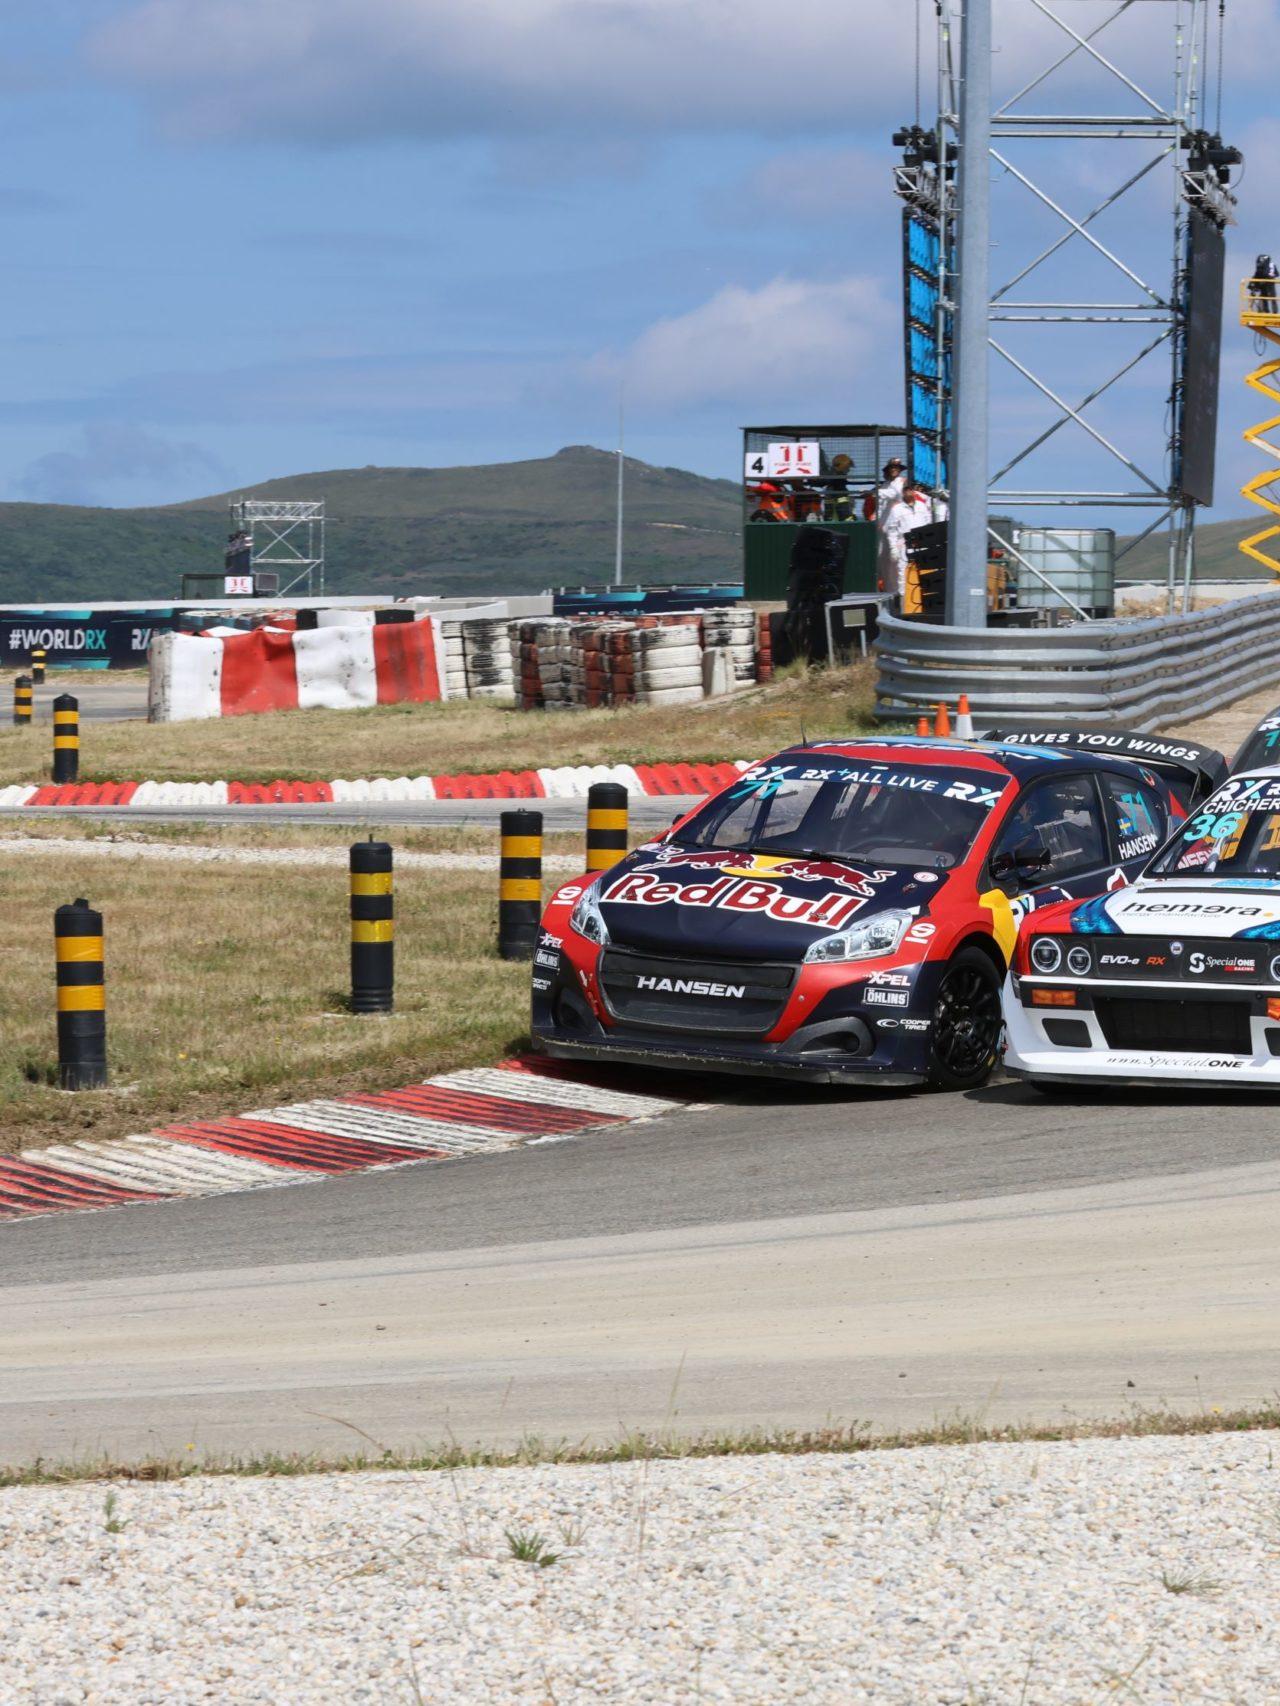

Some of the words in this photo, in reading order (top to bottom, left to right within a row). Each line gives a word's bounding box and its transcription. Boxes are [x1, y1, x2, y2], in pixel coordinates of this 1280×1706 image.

[751, 456, 764, 473] 4
[9, 628, 107, 650] #WORLDRX
[1003, 733, 1070, 745] GIVES
[1076, 734, 1123, 747] YOU
[1127, 738, 1200, 761] WINGS
[887, 775, 939, 791] LIVE
[943, 781, 1003, 807] RX
[1120, 791, 1152, 832] 71
[1183, 811, 1243, 842] 36
[1118, 833, 1157, 860] HANSEN
[1146, 956, 1166, 966] RX
[636, 975, 746, 998] HANSEN
[866, 970, 911, 987] XPEL
[867, 989, 907, 1005] ÖHLINS
